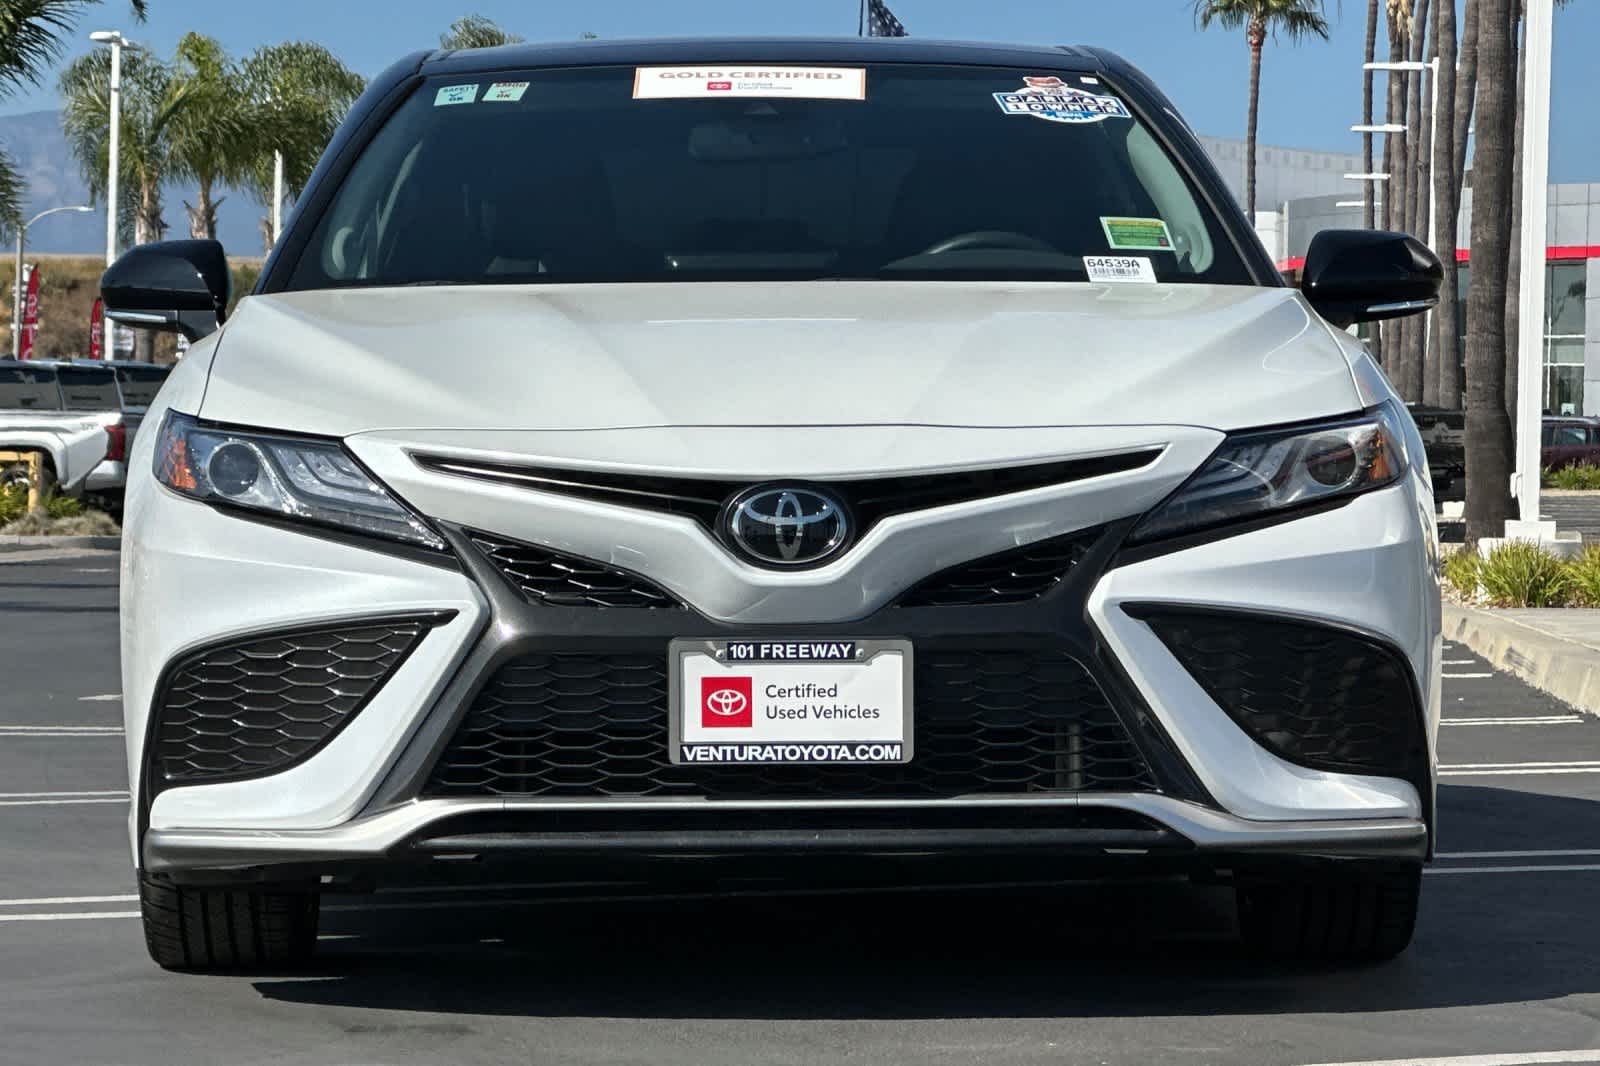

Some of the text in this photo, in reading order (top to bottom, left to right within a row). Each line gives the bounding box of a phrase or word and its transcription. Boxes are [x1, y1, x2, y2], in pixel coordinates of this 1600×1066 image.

[658, 71, 843, 80] GOLD CERTIFIED
[1005, 95, 1114, 106] CARFAX
[1029, 103, 1119, 114] OWNER
[1087, 258, 1140, 268] 64539A
[730, 643, 851, 659] 101 FREEWAY
[765, 683, 838, 698] Certified
[765, 704, 880, 719] Used Vehicles
[681, 745, 902, 761] VENTURATOYOTA.COM
